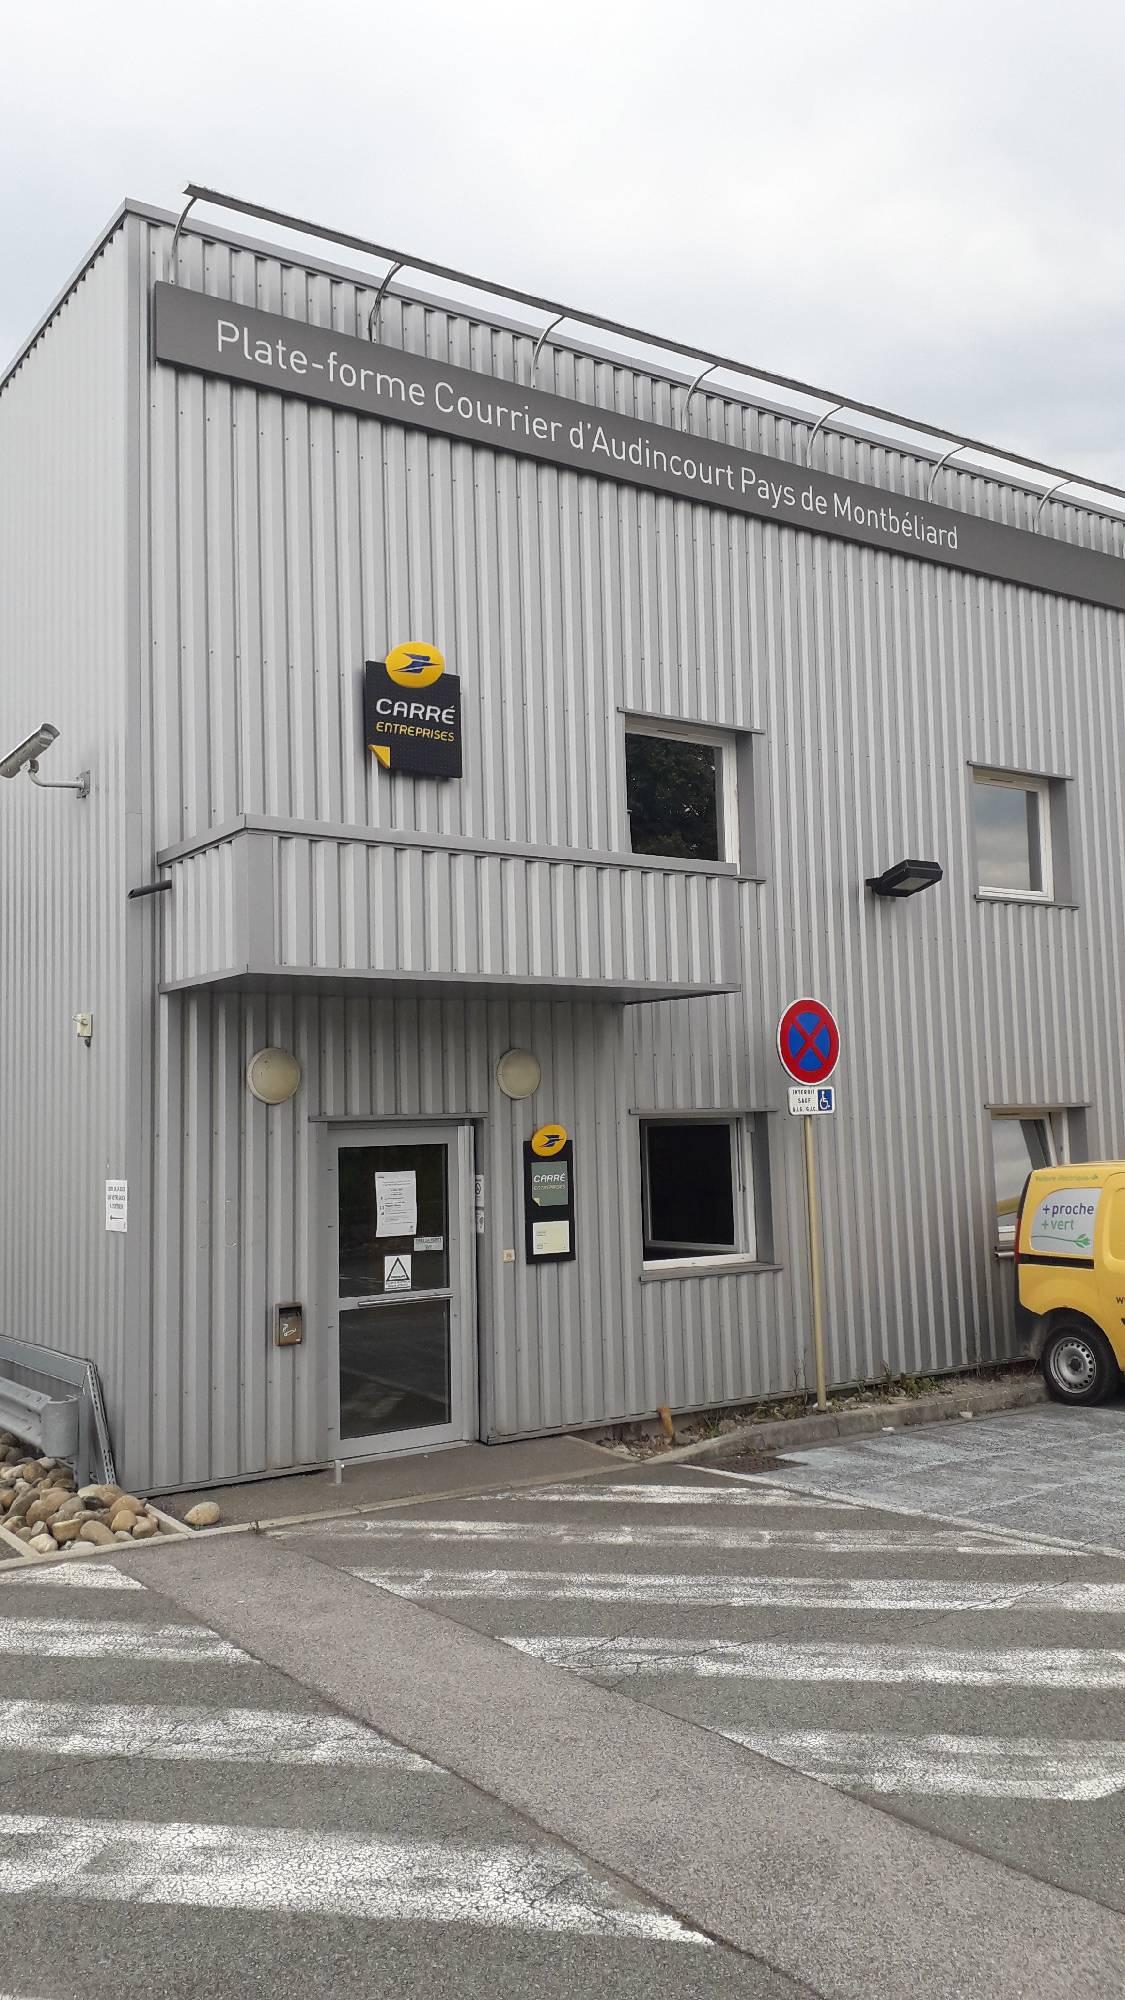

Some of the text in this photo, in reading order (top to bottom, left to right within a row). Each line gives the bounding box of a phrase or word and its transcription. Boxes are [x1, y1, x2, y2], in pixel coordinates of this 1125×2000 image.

[216, 318, 959, 550] Plate-forme Courrier d'Audincourt Pays de Montbéliard
[375, 698, 456, 725] CARRÉ
[375, 721, 455, 742] ENTREPRISES
[533, 1172, 566, 1183] CARRÉ
